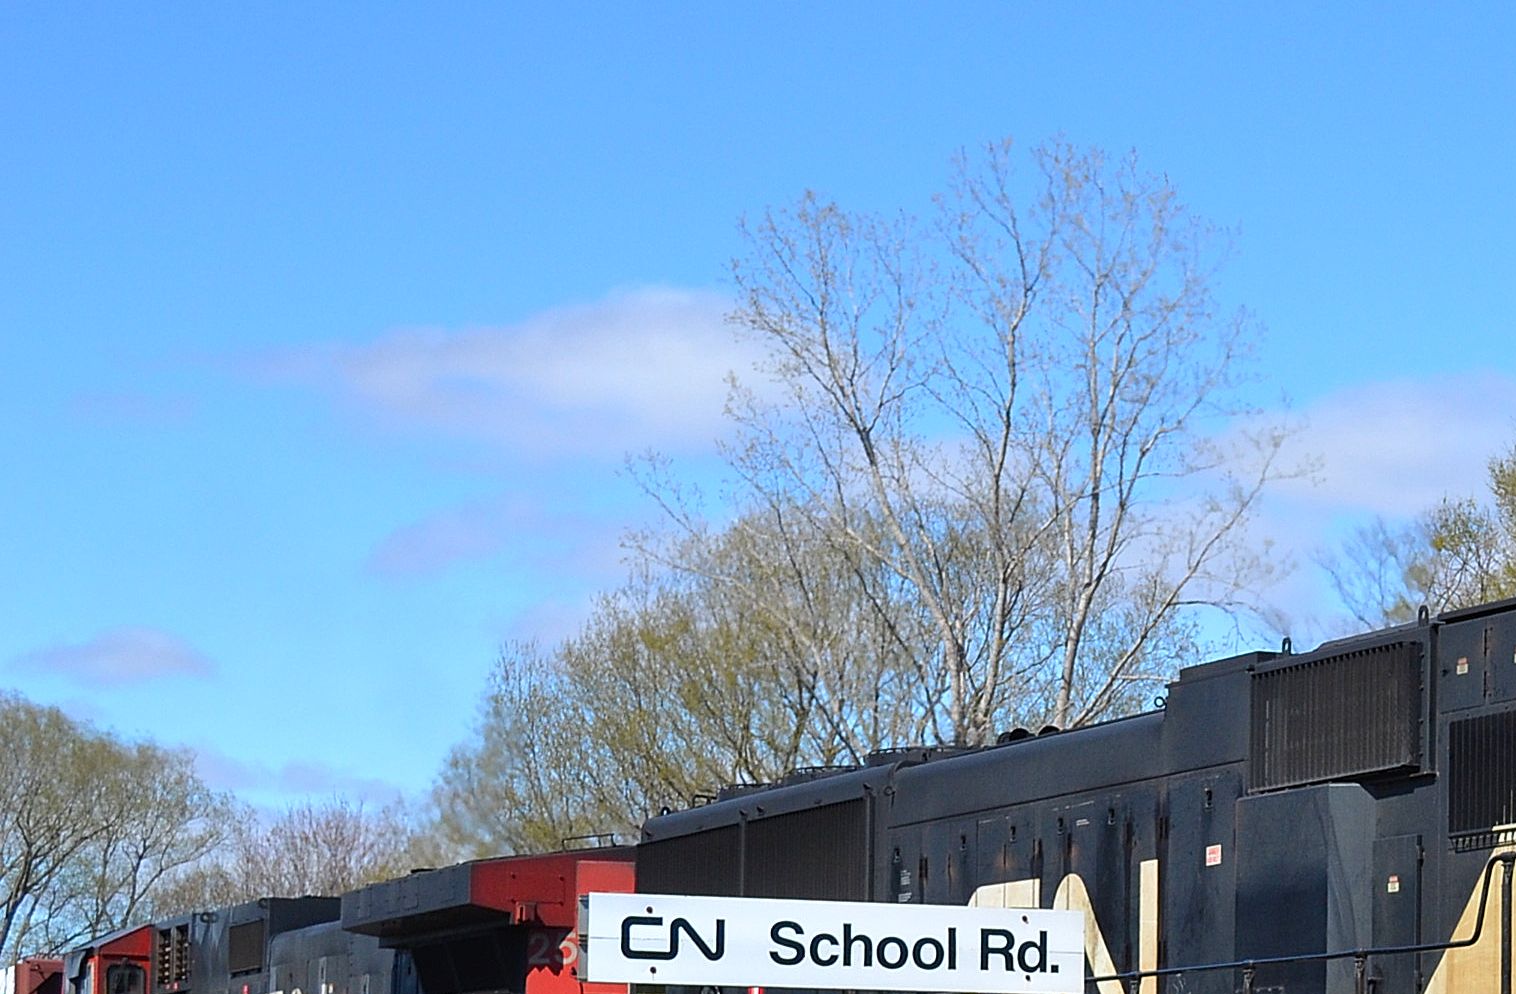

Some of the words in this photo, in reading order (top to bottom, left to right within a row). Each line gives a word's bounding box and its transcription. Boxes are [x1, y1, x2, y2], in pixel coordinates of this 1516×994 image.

[620, 915, 726, 962] CN
[769, 920, 957, 971] School
[980, 927, 1060, 974] Rd.
